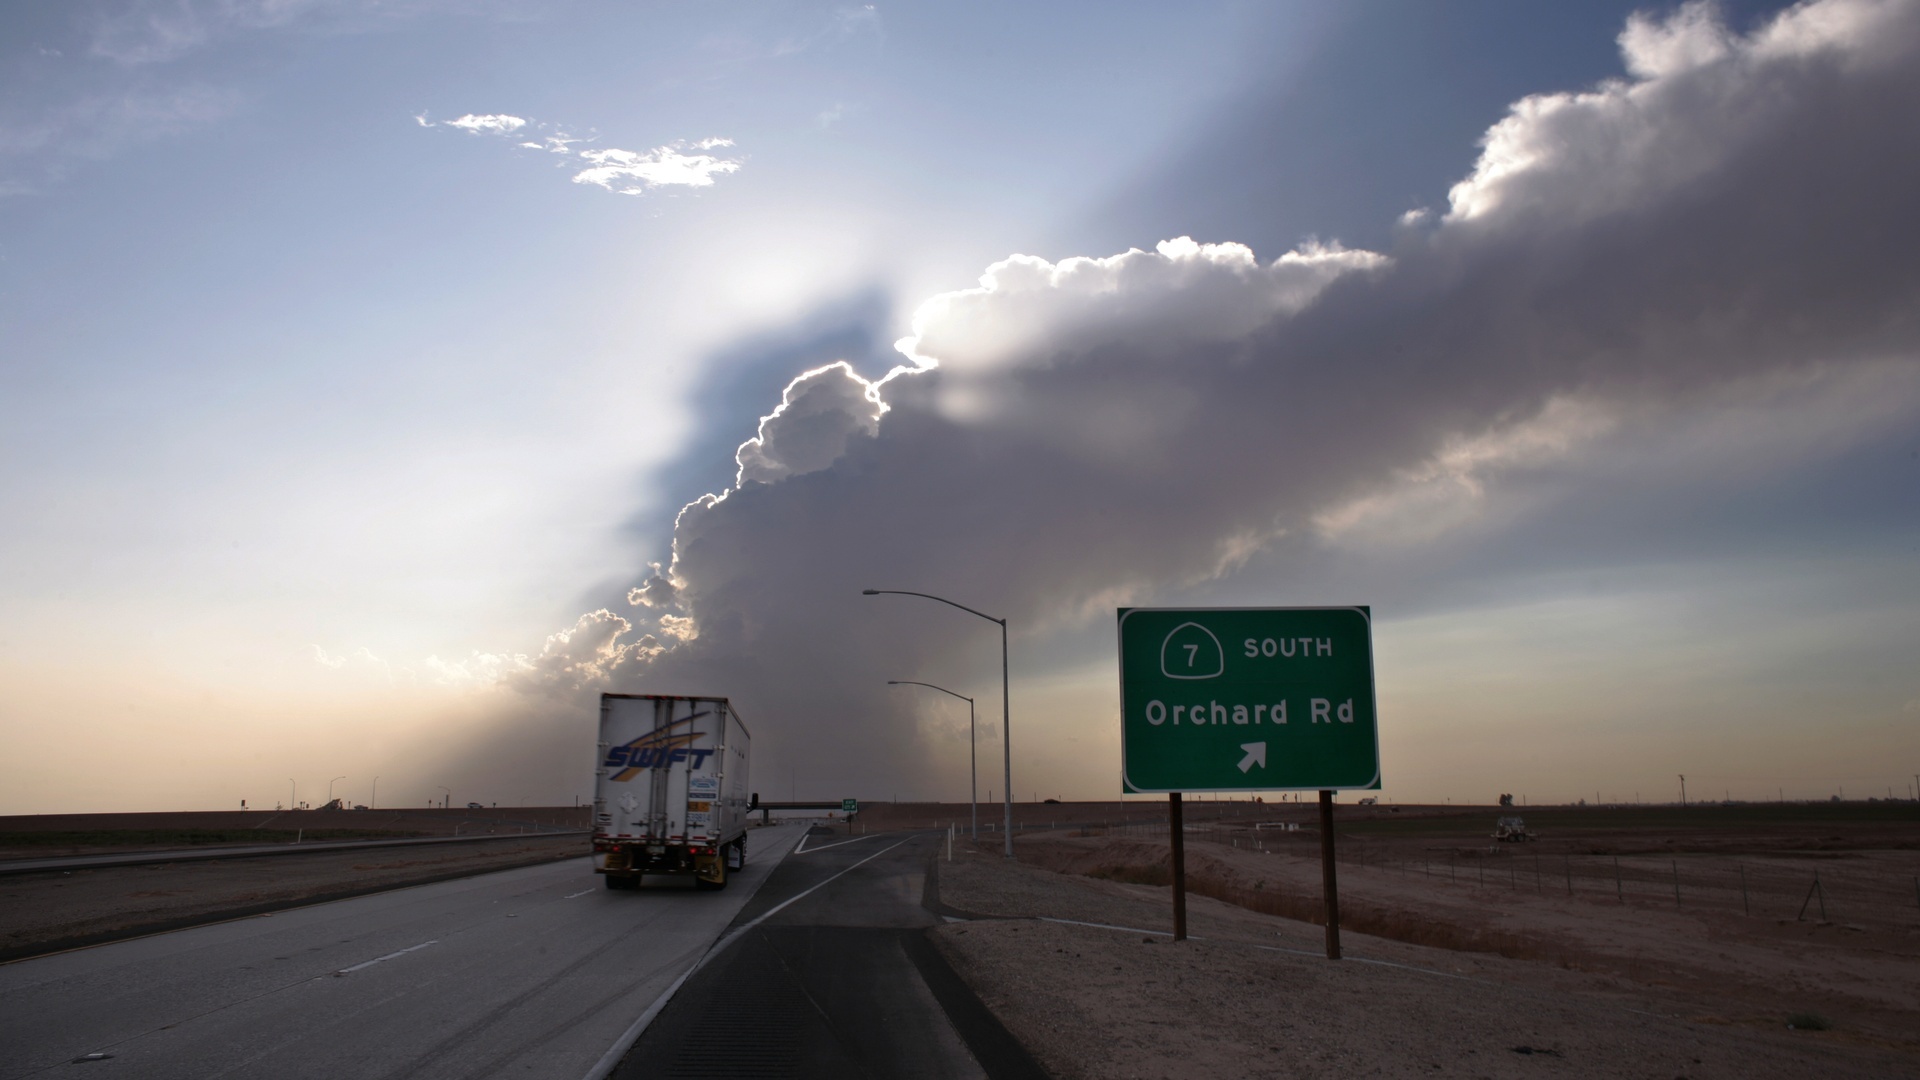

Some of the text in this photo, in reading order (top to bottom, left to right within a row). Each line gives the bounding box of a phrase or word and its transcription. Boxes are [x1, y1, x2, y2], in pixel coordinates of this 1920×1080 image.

[1183, 637, 1332, 667] 7 SOUTH
[1145, 698, 1354, 726] Orchard Rd
[605, 746, 714, 770] SWIFT
